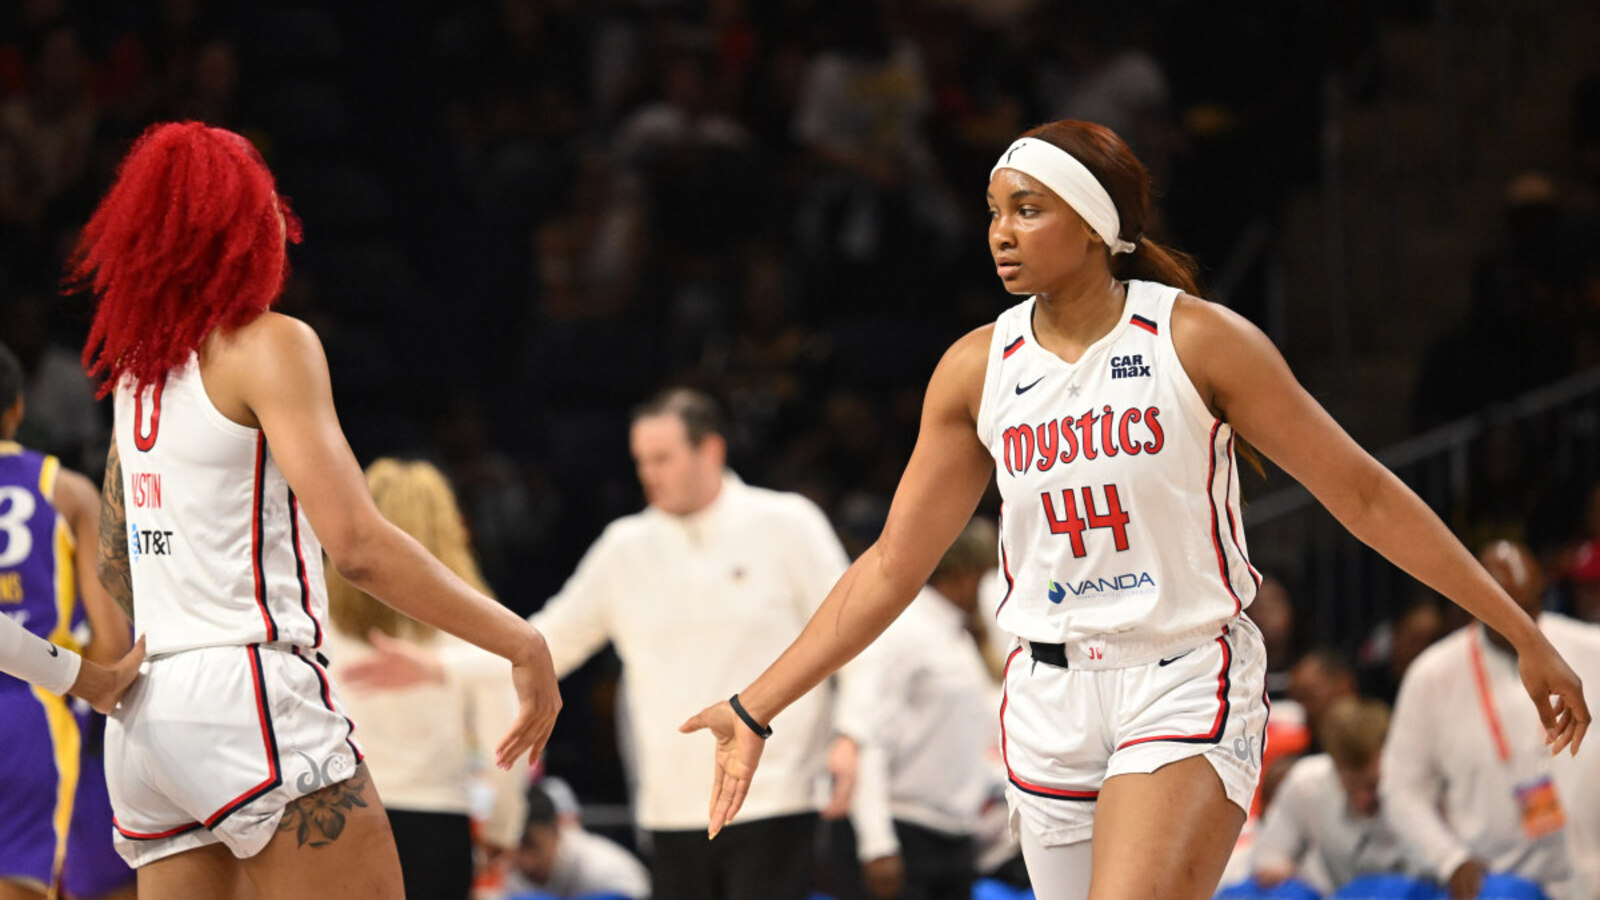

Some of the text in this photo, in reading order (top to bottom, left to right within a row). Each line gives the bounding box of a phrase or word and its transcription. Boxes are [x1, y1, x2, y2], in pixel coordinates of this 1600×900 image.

[1110, 354, 1143, 368] CAR
[1111, 365, 1151, 379] max
[1041, 484, 1130, 558] 44
[1066, 572, 1156, 596] VANDA
